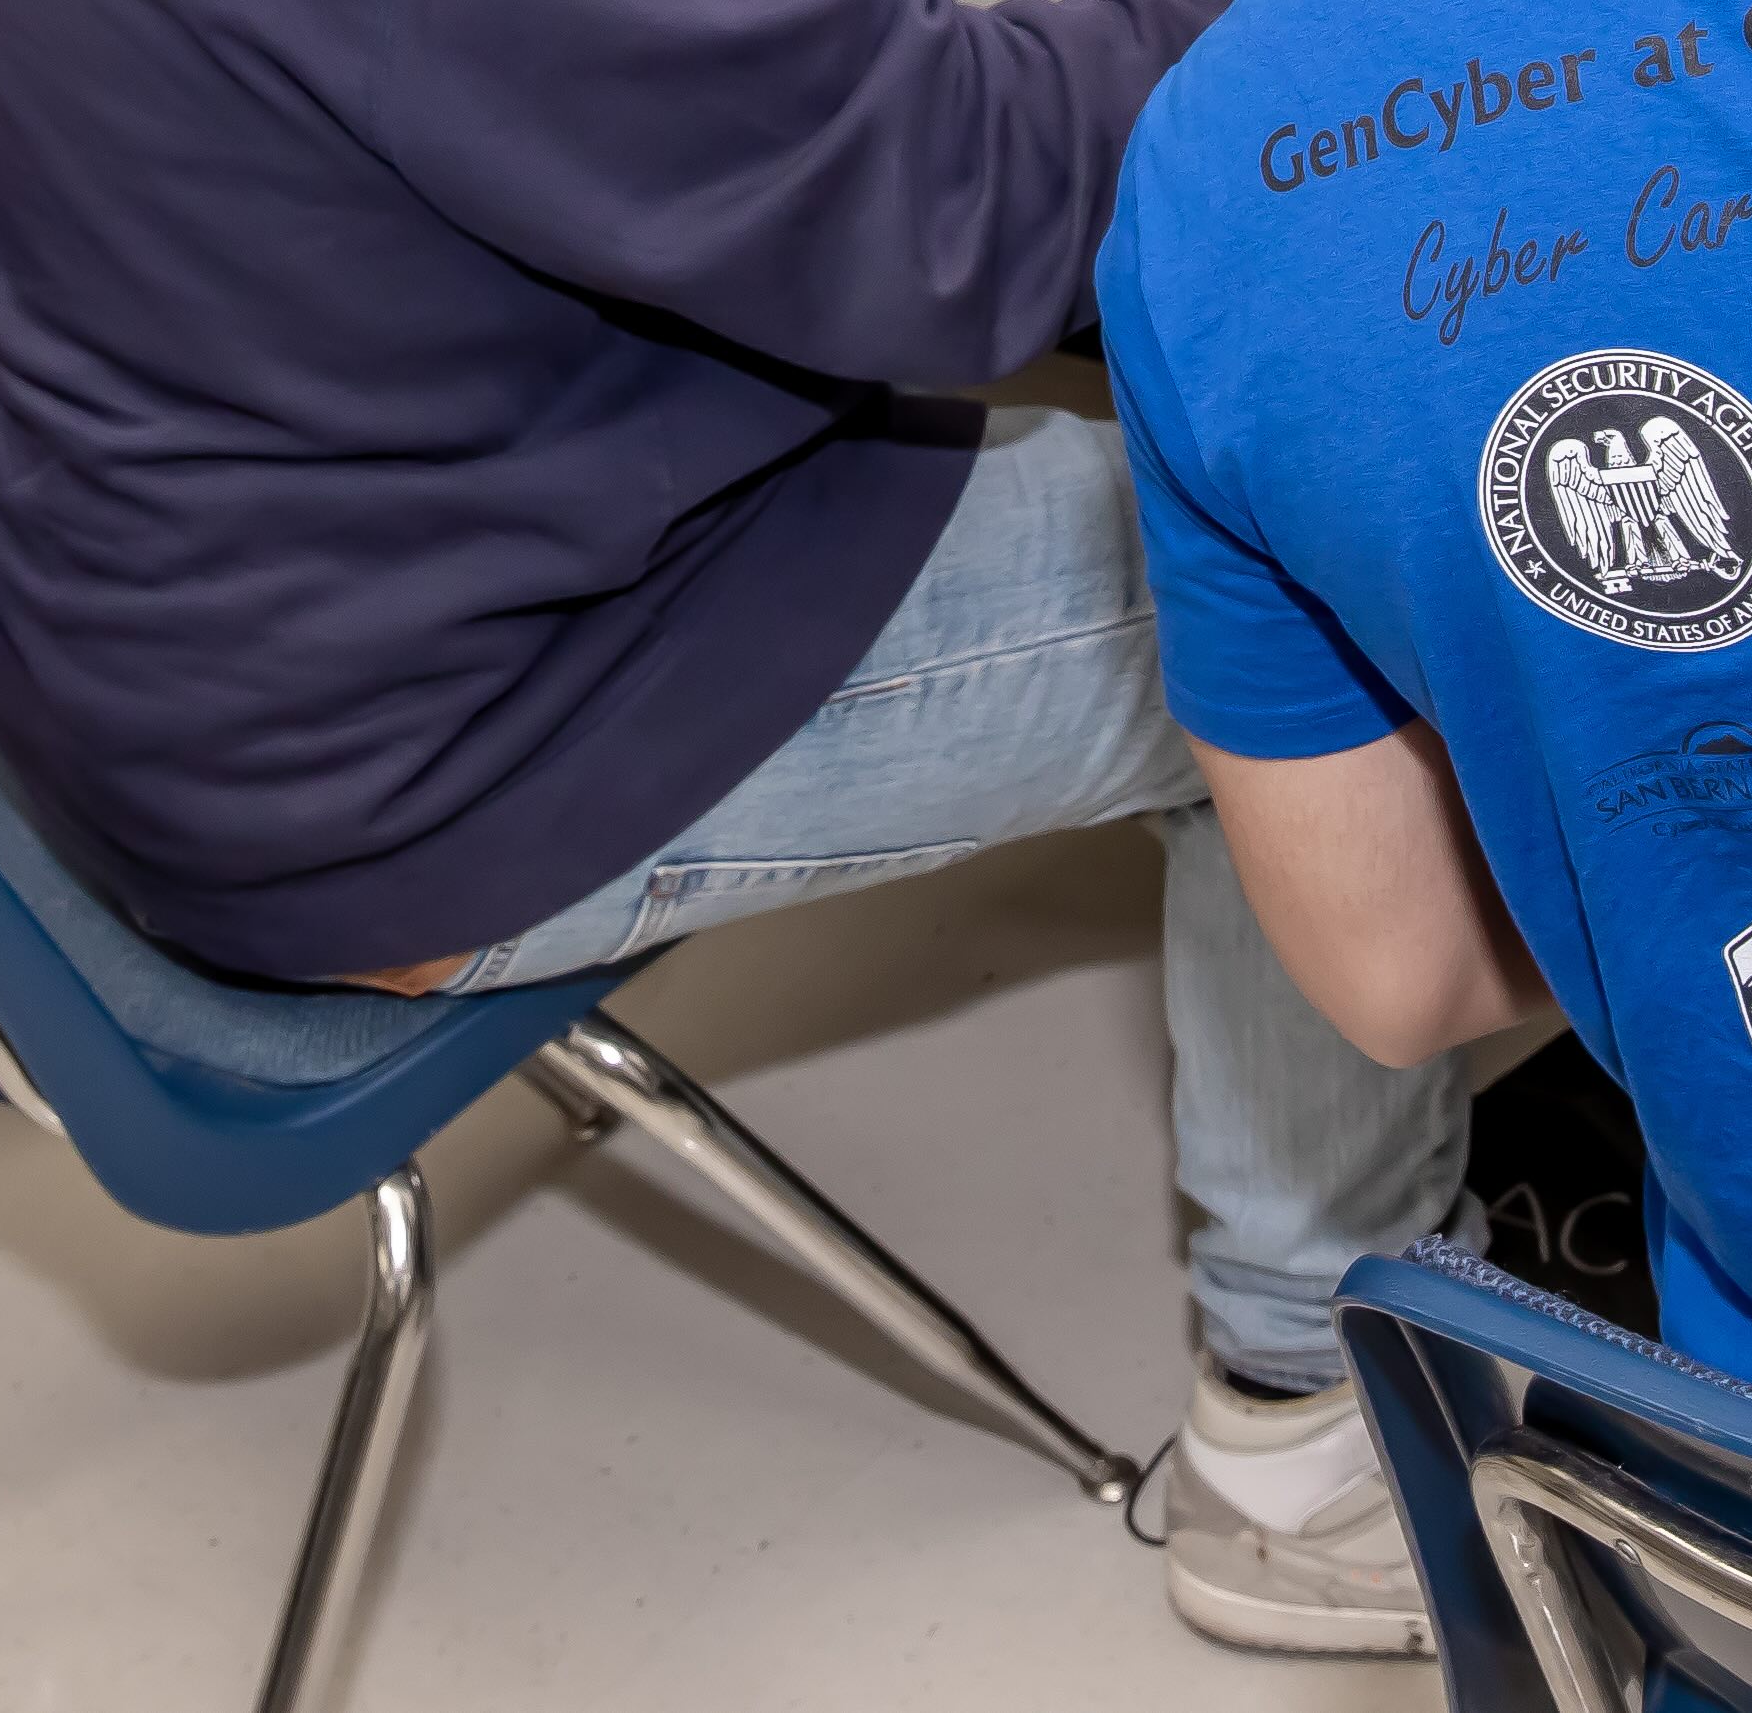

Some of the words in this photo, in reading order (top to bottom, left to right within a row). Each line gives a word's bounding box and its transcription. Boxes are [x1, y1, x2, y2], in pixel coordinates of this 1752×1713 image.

[1260, 49, 1596, 192] GenCyber
[1633, 21, 1714, 88] at
[1403, 207, 1588, 345] Cyber
[1492, 408, 1549, 555] NATIONAL
[1543, 362, 1691, 408] SECURITY
[1549, 584, 1627, 631] UNITED
[1633, 620, 1704, 642] STATES
[1707, 615, 1732, 635] OF
[1595, 779, 1668, 824] SAN
